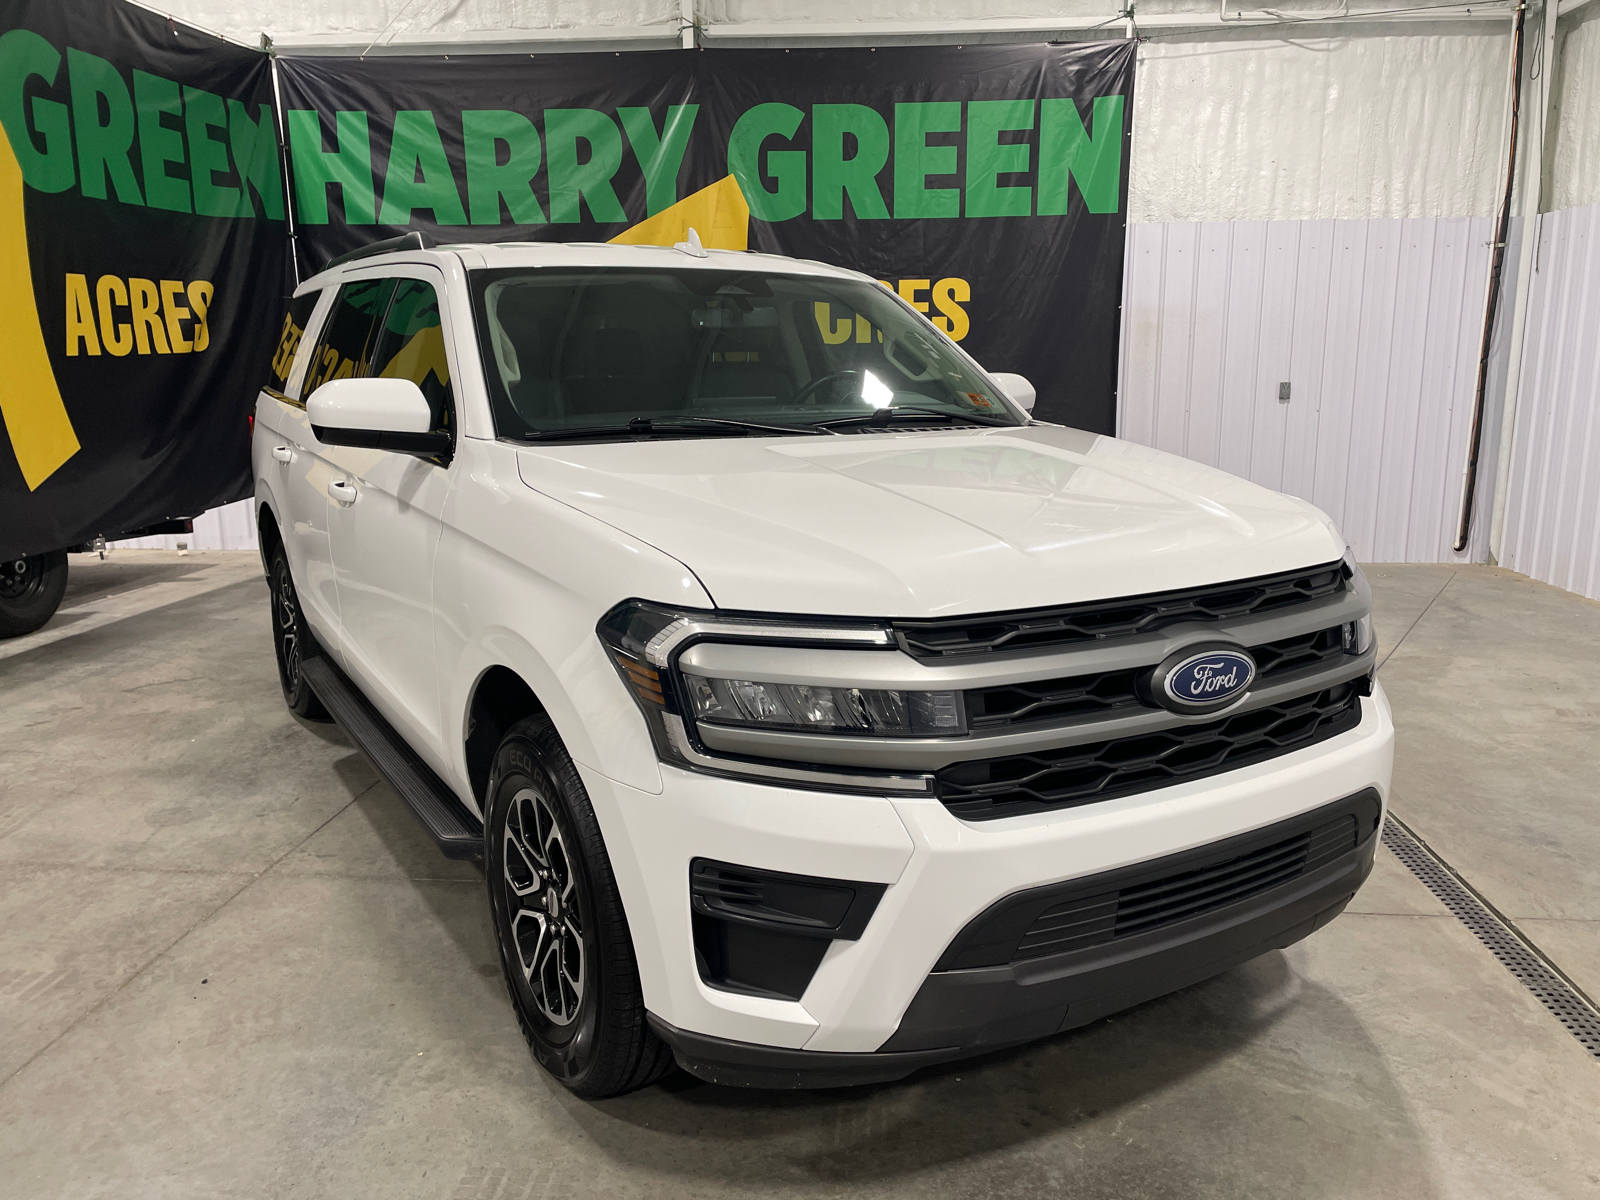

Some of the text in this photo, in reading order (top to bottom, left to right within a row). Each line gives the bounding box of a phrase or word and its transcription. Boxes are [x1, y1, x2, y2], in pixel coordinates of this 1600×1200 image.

[0, 29, 285, 221] GREEN
[287, 95, 1125, 226] HARRY GREEN
[65, 273, 215, 357] ACRES
[1190, 662, 1237, 695] Ford
[509, 749, 532, 773] ECO
